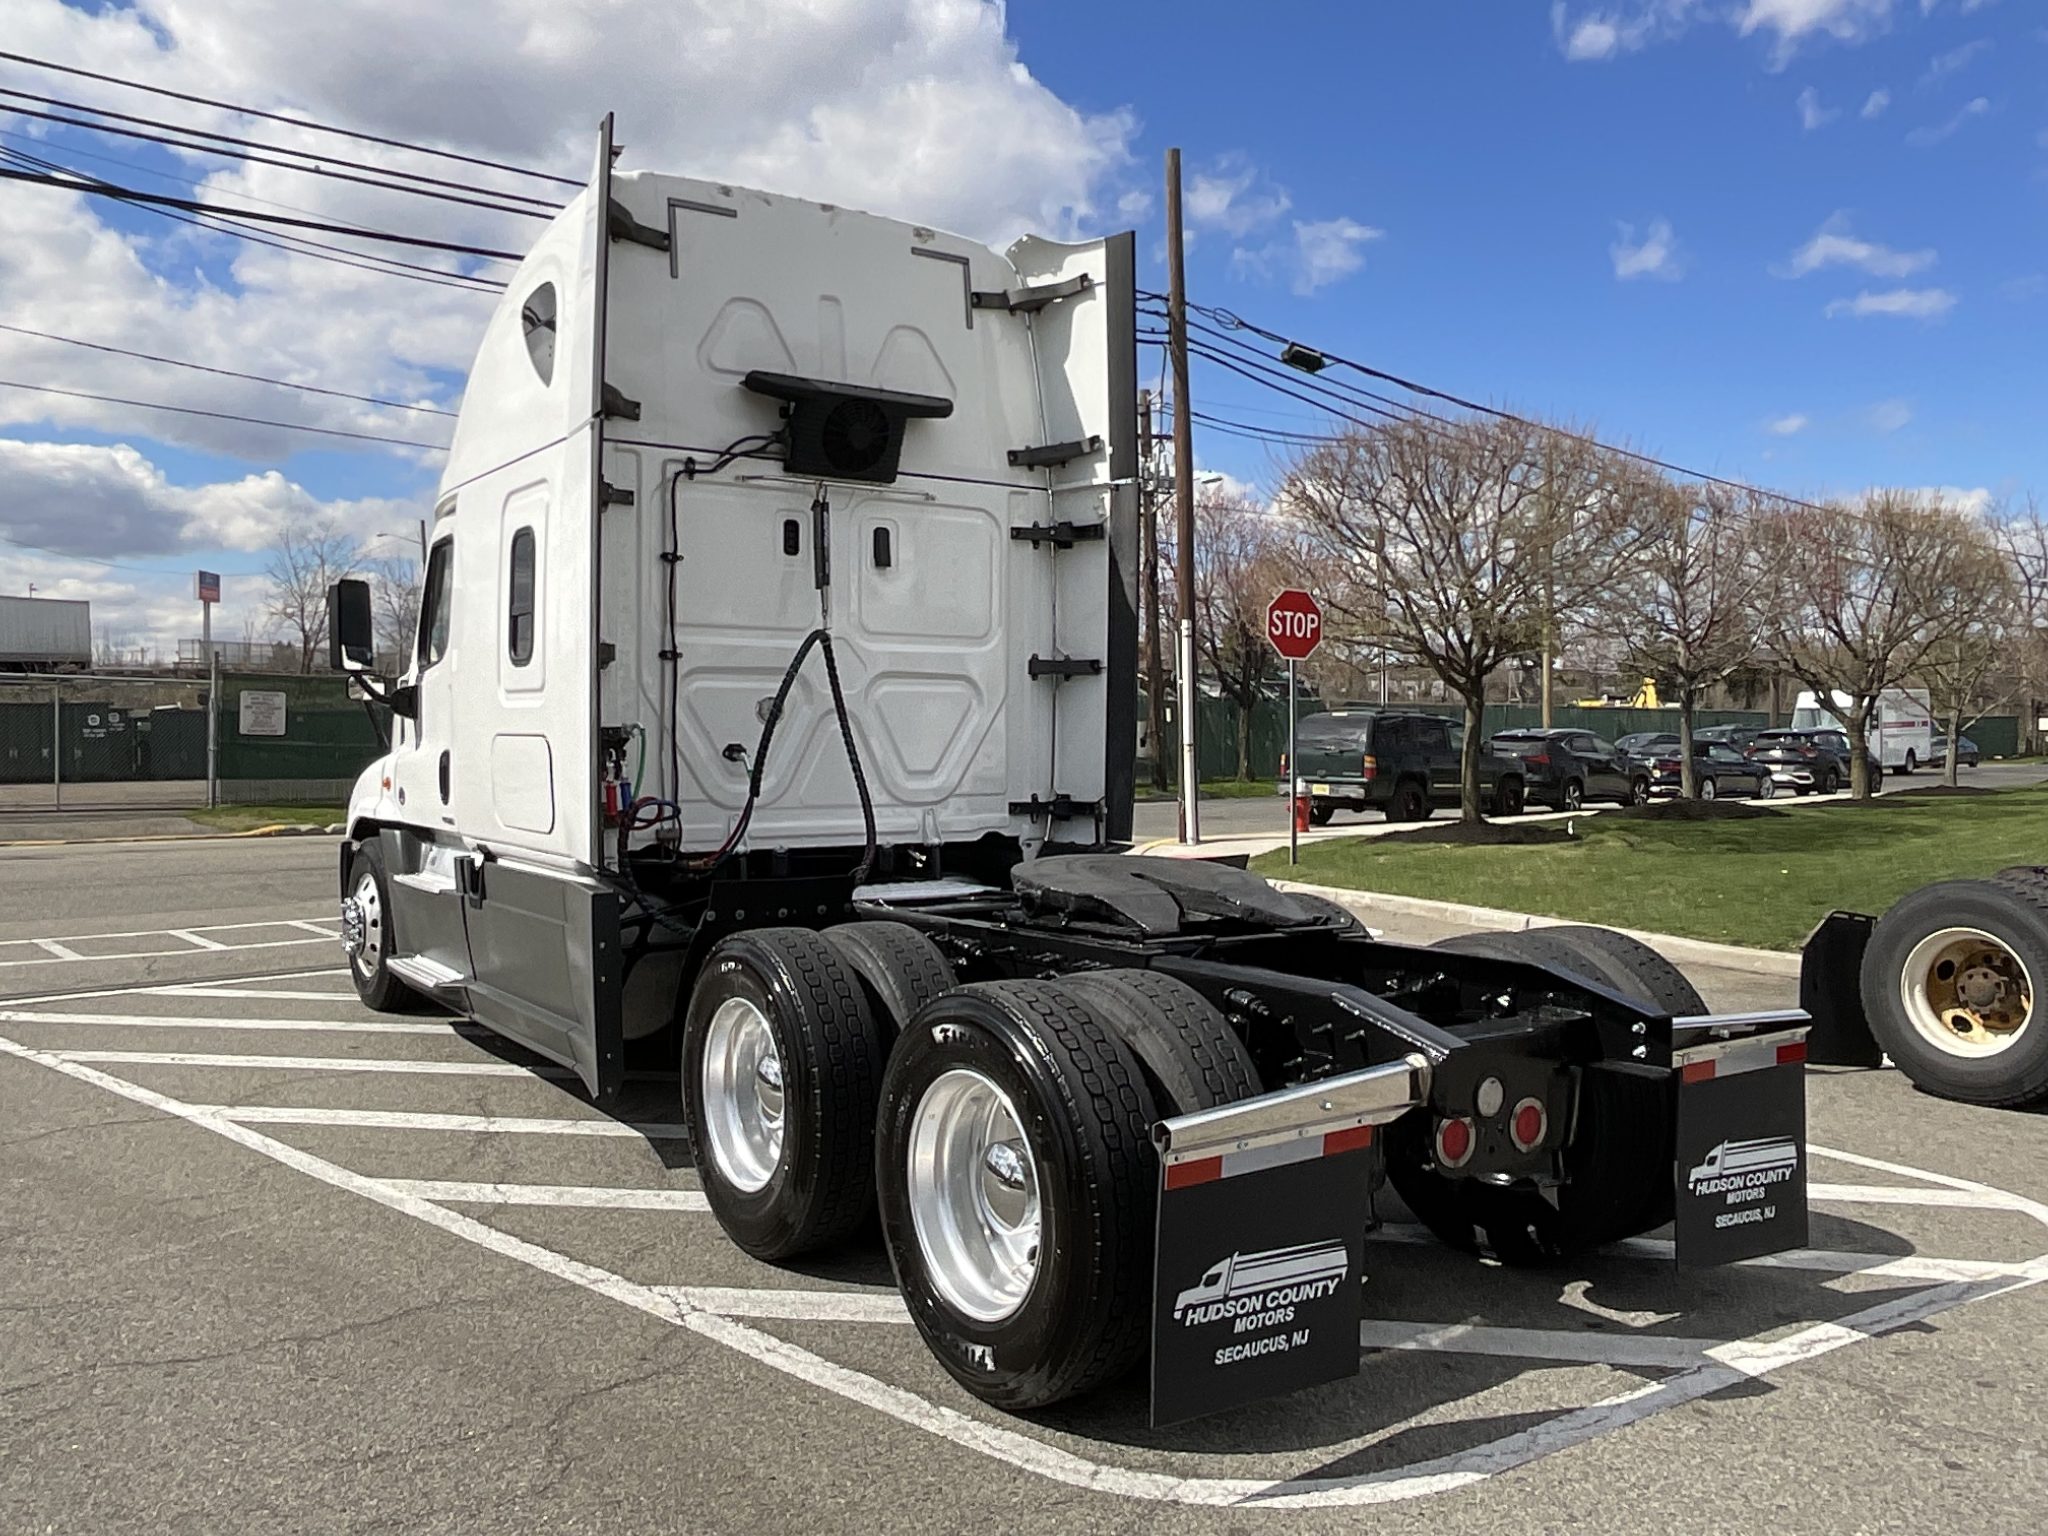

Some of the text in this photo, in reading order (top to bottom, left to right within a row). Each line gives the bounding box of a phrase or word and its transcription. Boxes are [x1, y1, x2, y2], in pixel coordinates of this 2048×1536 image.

[1271, 610, 1319, 639] STOP
[1695, 1167, 1792, 1196] HUDSON COUNTY
[1726, 1187, 1765, 1205] MOTORS
[1715, 1205, 1776, 1228] SECAUCUS, NJ
[1185, 1278, 1340, 1327] HUDSON COUNTY
[1233, 1306, 1295, 1334] MOTORS
[1214, 1328, 1310, 1365] SECAUCUS, NJ
